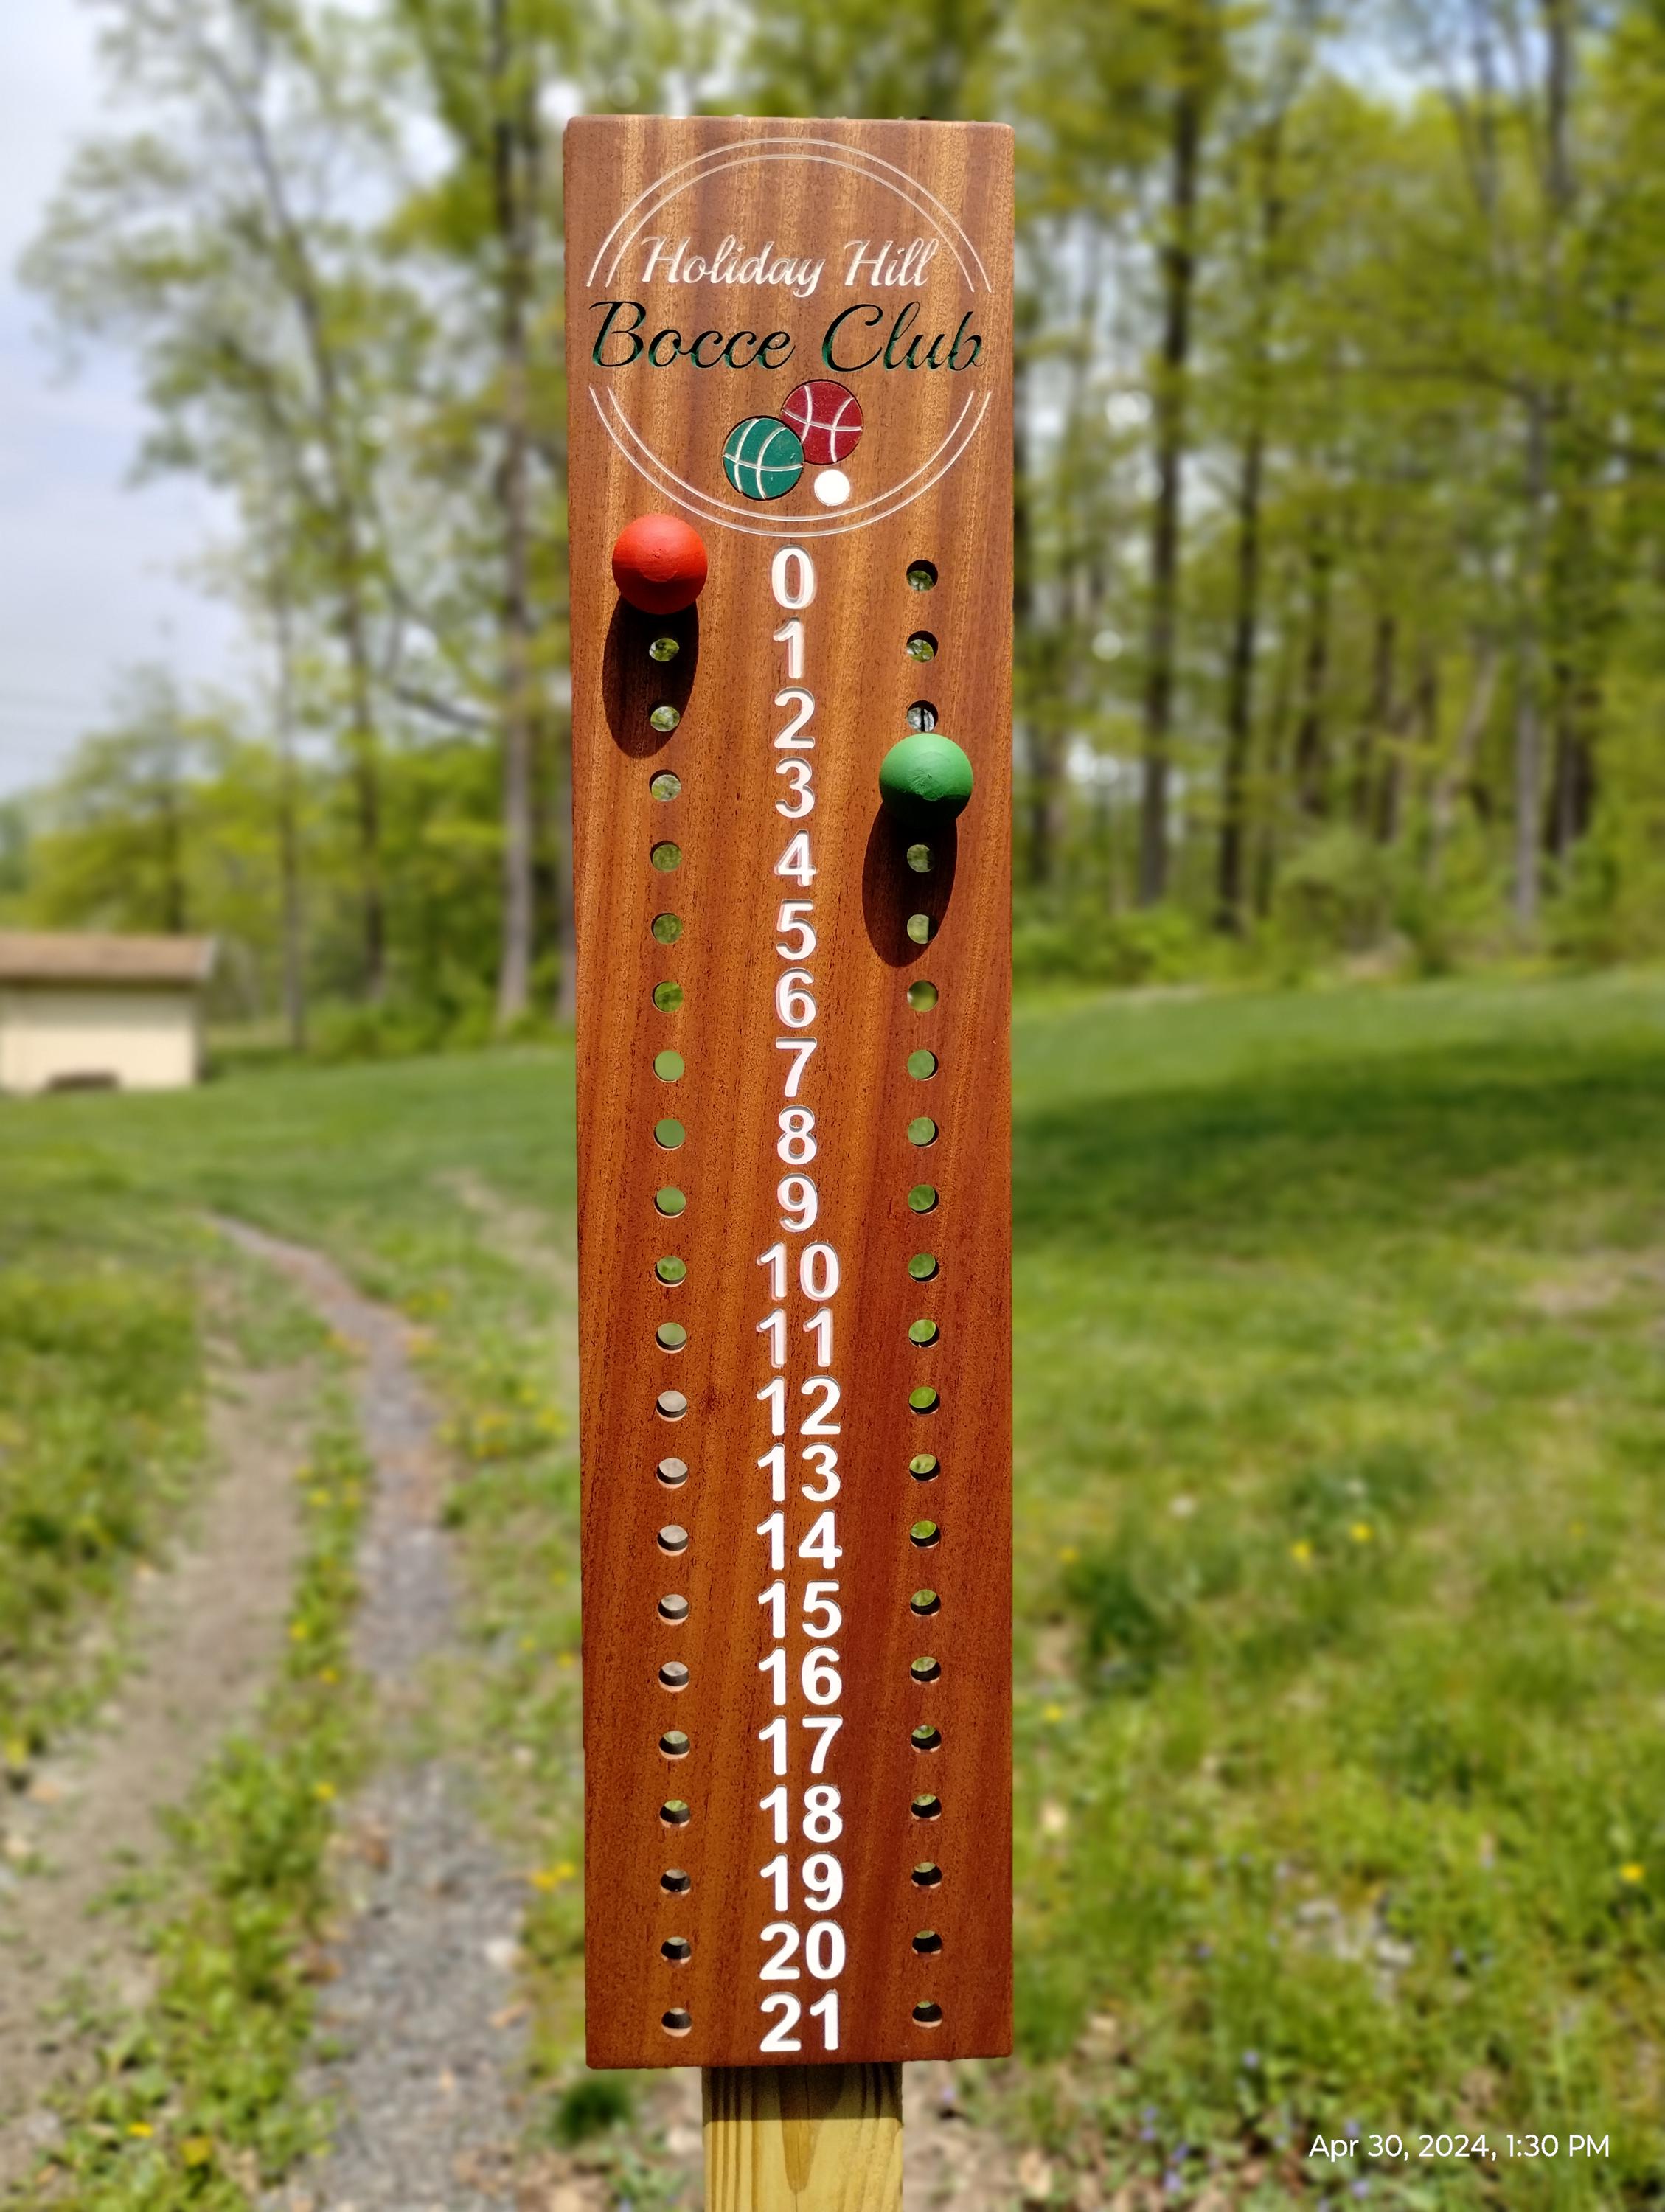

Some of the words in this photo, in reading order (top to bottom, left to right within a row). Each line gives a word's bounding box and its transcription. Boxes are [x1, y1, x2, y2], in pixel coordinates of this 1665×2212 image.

[641, 234, 825, 298] Holiday
[844, 237, 939, 287] Hill
[589, 301, 796, 369] Bocce
[821, 301, 985, 372] Club
[771, 546, 816, 610] 0
[773, 619, 804, 679] 1
[774, 686, 816, 750] 2
[775, 757, 816, 818] 3
[774, 830, 817, 887] 4
[776, 899, 817, 961] 5
[775, 969, 817, 1029] 6
[775, 1037, 818, 1098] 7
[776, 1105, 818, 1165] 8
[777, 1172, 818, 1233] 9
[757, 1242, 840, 1301] 10
[756, 1307, 838, 1368] 11
[757, 1374, 841, 1436] 12
[757, 1442, 841, 1503] 13
[756, 1509, 843, 1571] 14
[757, 1579, 842, 1639] 15
[758, 1645, 843, 1706] 16
[758, 1714, 844, 1776] 17
[759, 1784, 844, 1844] 18
[759, 1851, 844, 1913] 19
[759, 1919, 847, 1980] 20
[759, 1989, 841, 2053] 21
